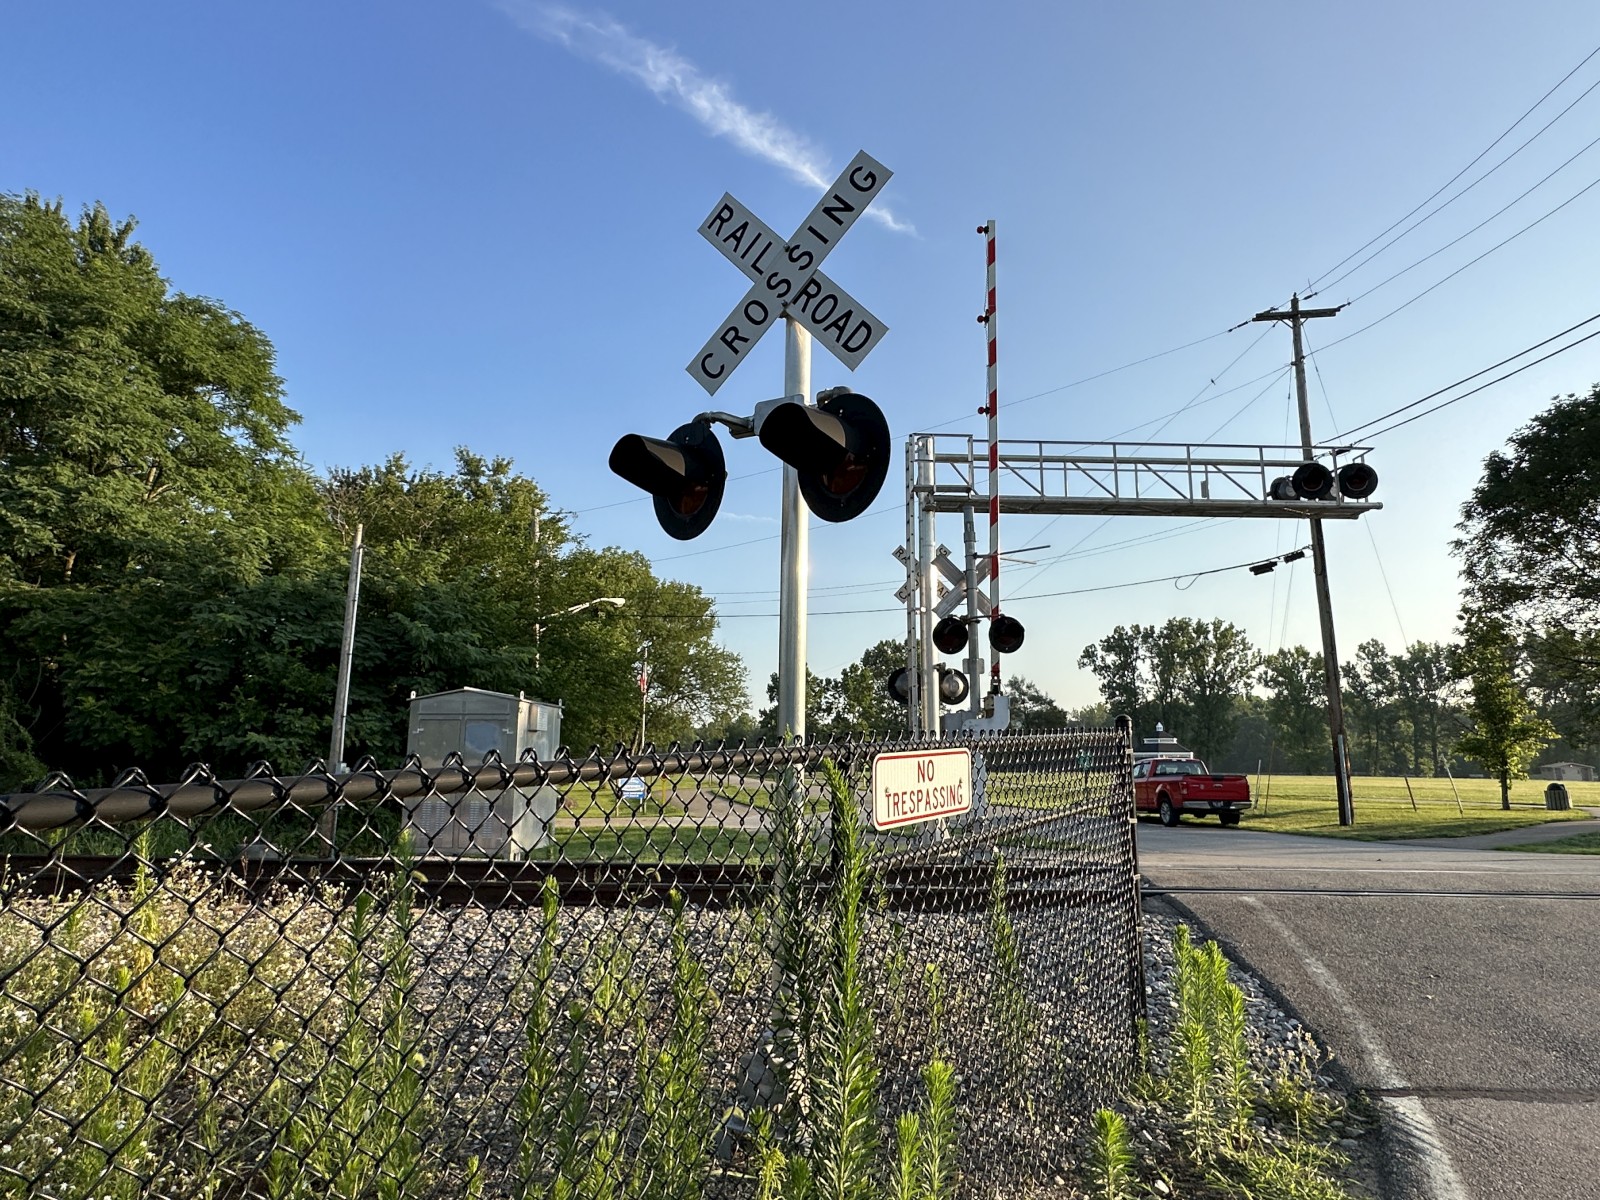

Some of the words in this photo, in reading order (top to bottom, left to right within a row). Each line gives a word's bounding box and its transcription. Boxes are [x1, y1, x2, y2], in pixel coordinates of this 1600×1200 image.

[700, 166, 876, 379] CROSSING
[918, 759, 934, 783] NO
[885, 784, 963, 818] TRESPASSING
